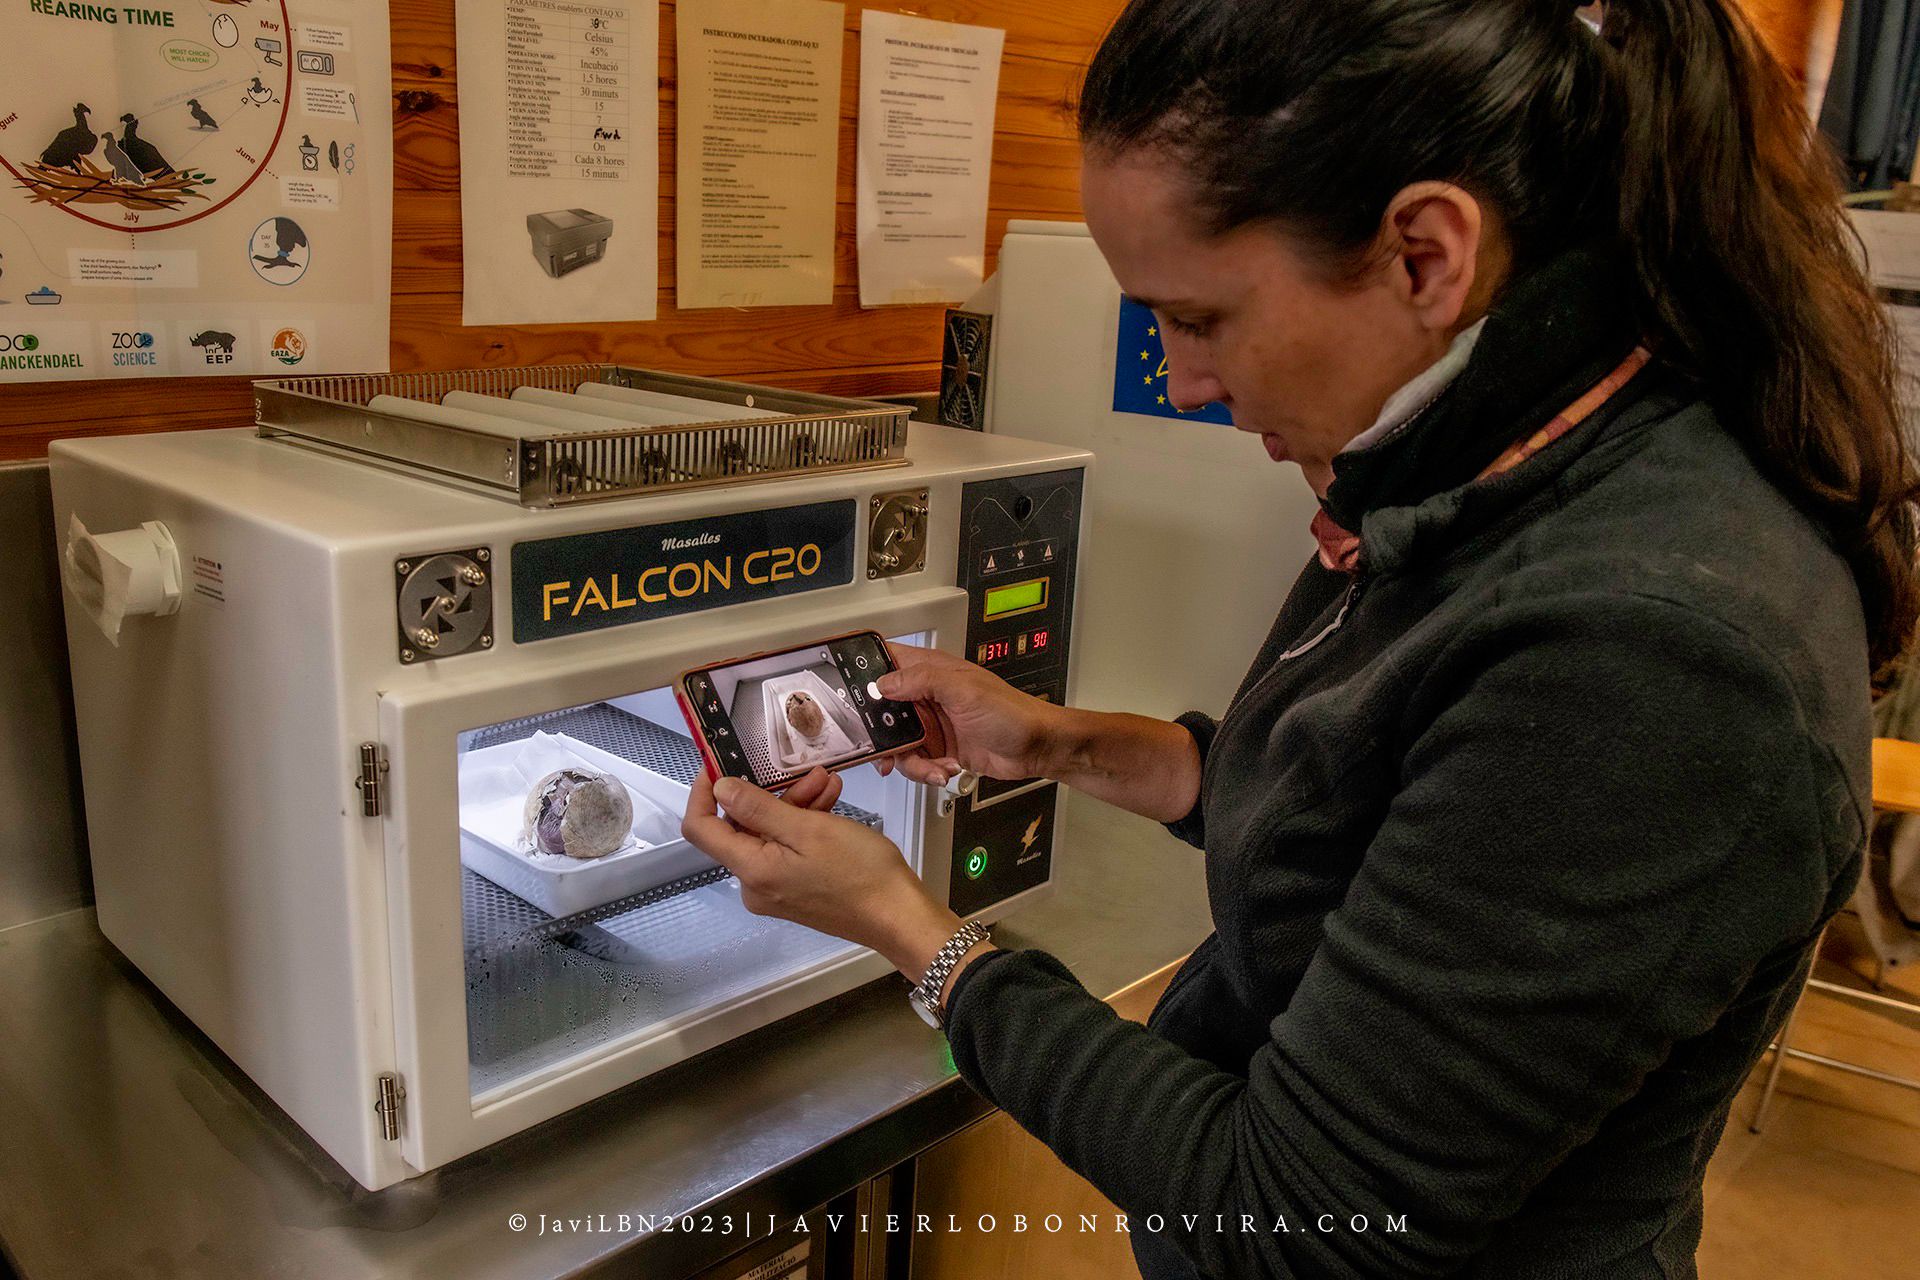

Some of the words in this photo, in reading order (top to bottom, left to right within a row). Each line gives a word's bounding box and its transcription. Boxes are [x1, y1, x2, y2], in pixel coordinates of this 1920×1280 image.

[30, 0, 118, 24] REARING
[123, 8, 174, 27] TIME
[260, 20, 279, 32] May
[585, 32, 614, 43] Celsius
[170, 48, 186, 56] MOST
[186, 50, 210, 58] CHICKS
[590, 47, 609, 57] 45%
[580, 59, 618, 72] Incubació
[596, 74, 617, 85] hores
[580, 87, 590, 96] 30
[592, 88, 619, 98] minuts
[595, 102, 604, 111] 15
[594, 142, 605, 151] On
[236, 147, 256, 164] June
[575, 154, 594, 164] Cada
[596, 156, 601, 164] 8
[604, 156, 625, 166] hores
[582, 168, 590, 177] 15
[592, 169, 619, 178] minuts
[124, 212, 139, 223] July
[113, 352, 156, 366] SCIENCE
[206, 354, 233, 364] EEP
[662, 532, 721, 551] Masalles
[543, 556, 732, 622] FALCON
[743, 543, 822, 586] C20
[1033, 632, 1047, 648] 90
[748, 1255, 784, 1278] MATERIAL
